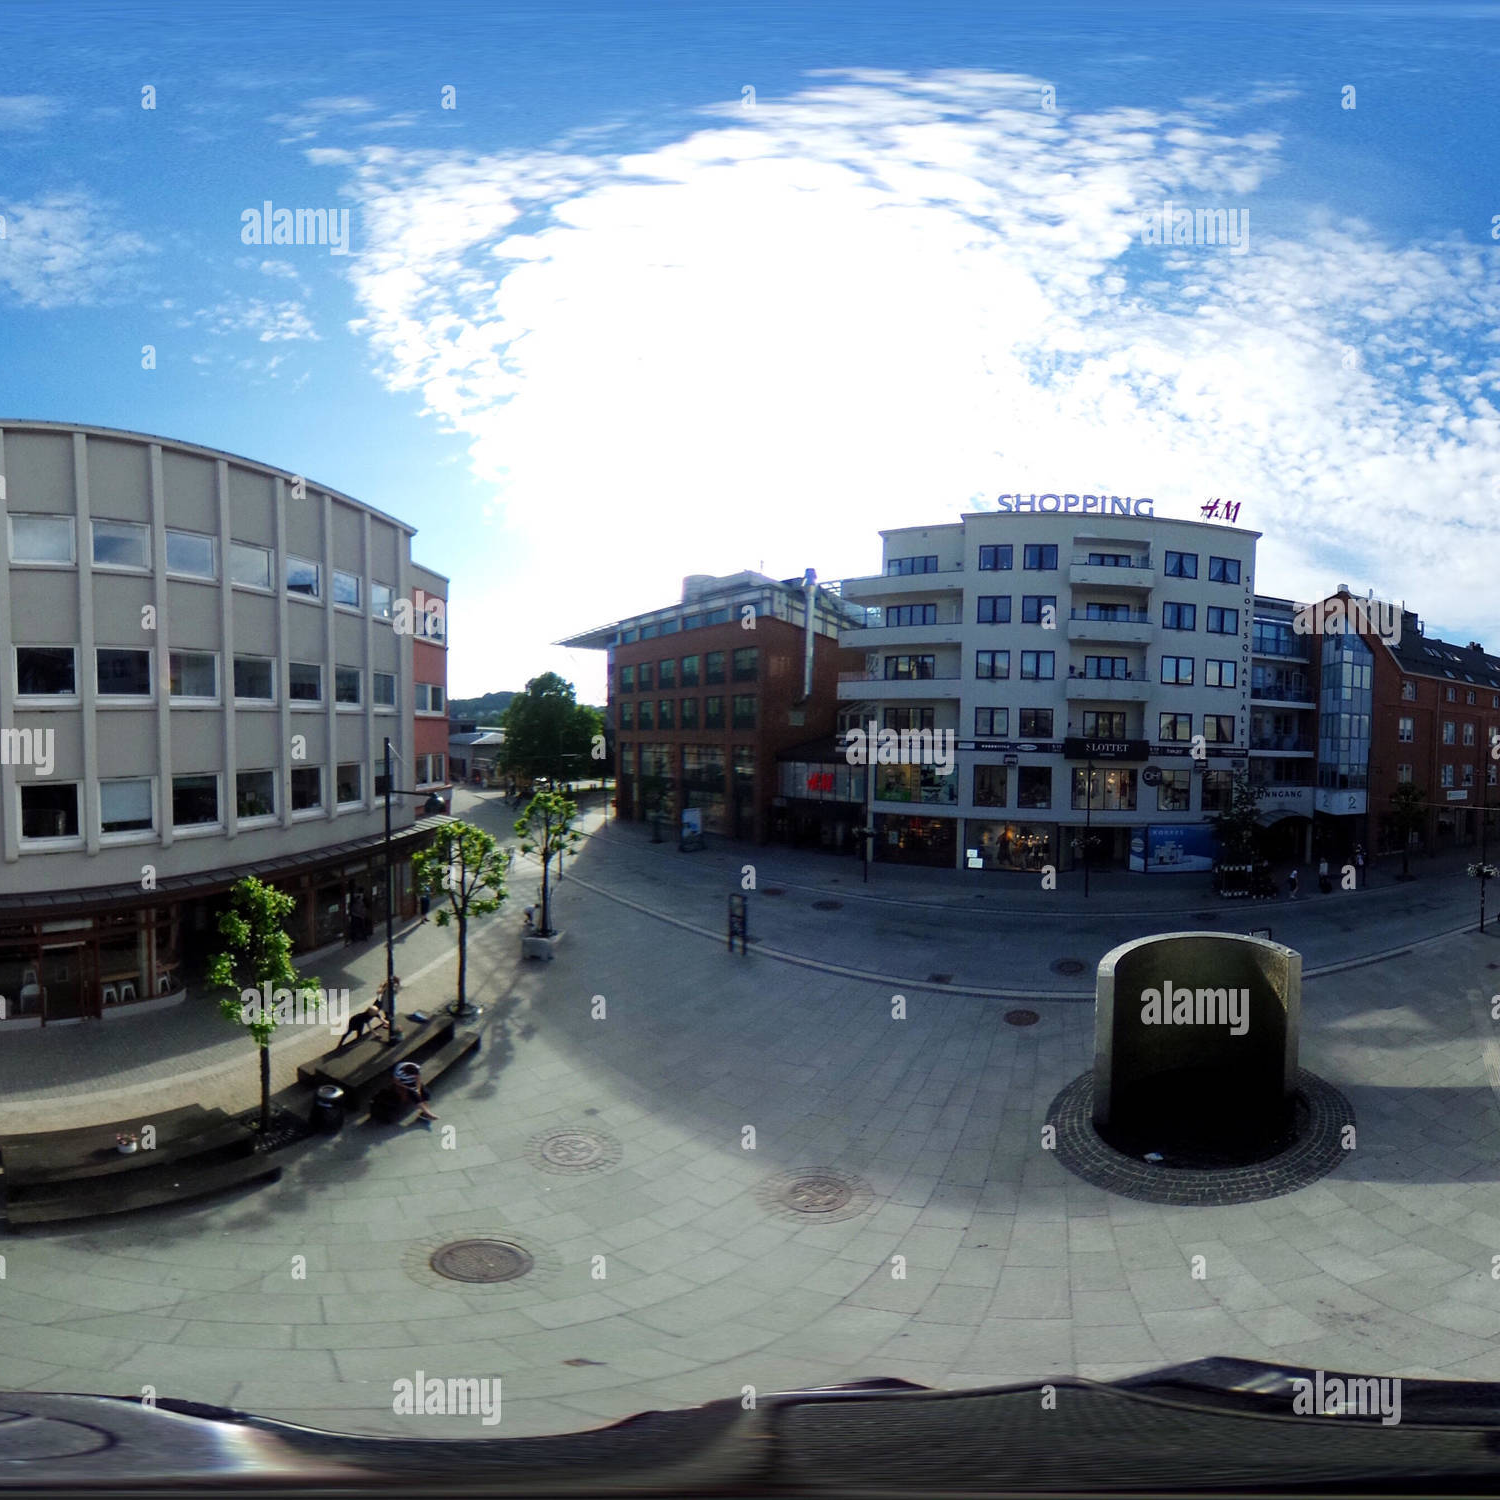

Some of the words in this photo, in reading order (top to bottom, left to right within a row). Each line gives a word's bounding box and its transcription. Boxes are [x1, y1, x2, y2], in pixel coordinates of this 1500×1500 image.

[998, 494, 1154, 517] SHOPPING
[1240, 575, 1251, 748] SLOTTSQUARTALET
[1085, 743, 1130, 752] SLOTTET
[1347, 796, 1357, 809] 2
